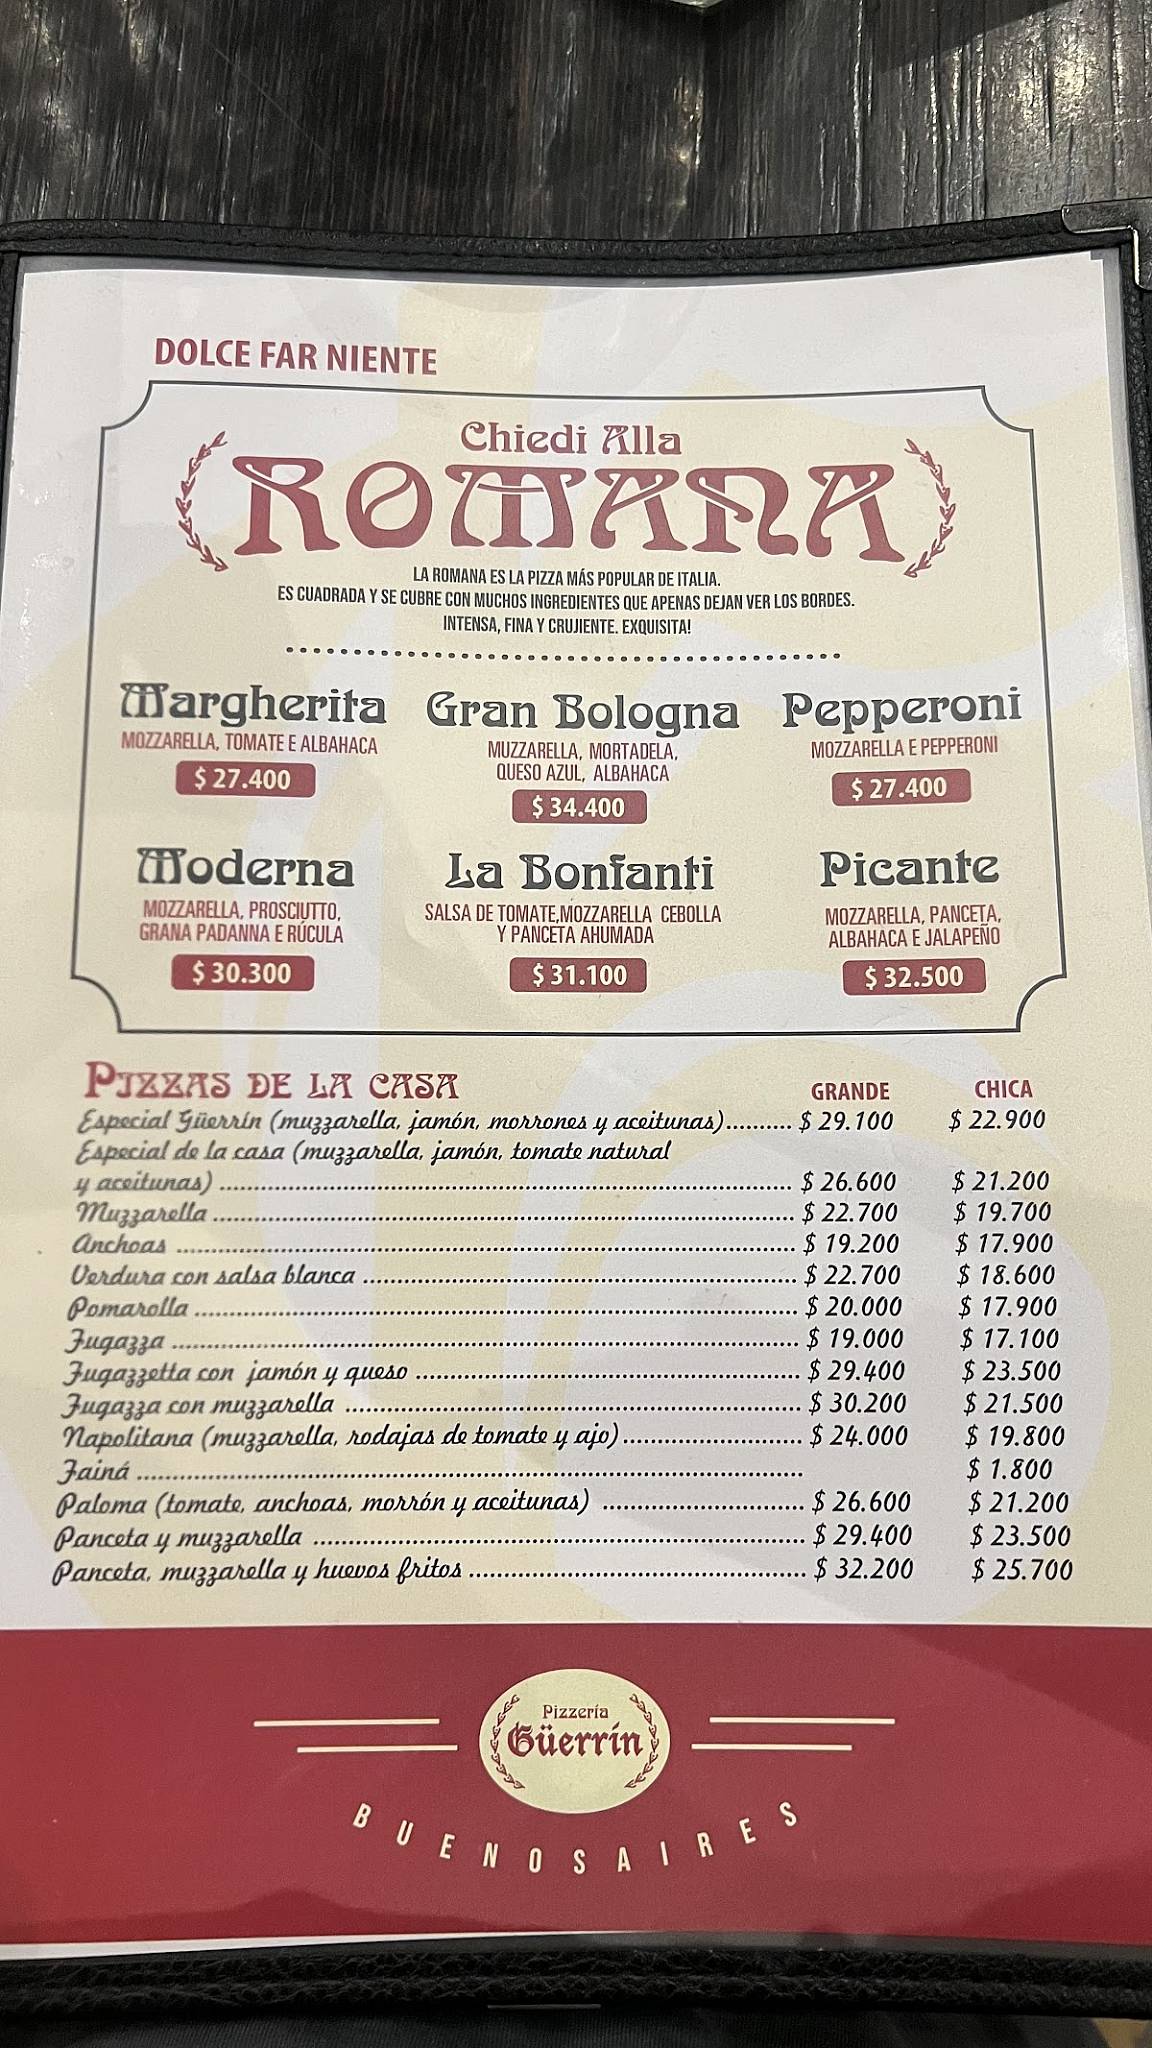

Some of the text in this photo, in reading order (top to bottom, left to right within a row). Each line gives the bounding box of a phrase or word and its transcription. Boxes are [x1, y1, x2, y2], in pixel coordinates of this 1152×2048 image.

[155, 337, 437, 375] DOLCE FAR NIENTE
[460, 421, 682, 455] Chiedi Alla
[232, 456, 905, 562] ROMANA
[413, 566, 721, 587] LA ROMANA ES LA PIZZA MÁS POPULAR DE ITALIA.
[278, 585, 855, 611] ES CUADRADA SE CUBRE CON MUCHOS INGREDIENTES QUE APENAS DEJAN VER LOS BORDES.
[443, 615, 691, 635] INTENSA, FINA CRUJIENTE. EXQUISITA!
[120, 682, 387, 728] Margherita
[426, 690, 740, 738] Gran Bologna
[782, 686, 1022, 735] Pepperoni
[121, 731, 378, 754] MOZZARELLA, TOMATE ALBAHACA
[488, 741, 678, 762] MUZZARELLA, MORTADELA,
[811, 735, 998, 759] MOZZARELLA PEPPERONI
[213, 768, 291, 790] 27.400
[496, 764, 669, 783] QUESO AZUL, ALBAHACA
[869, 776, 947, 800] 27.400
[550, 797, 625, 818] 34.400
[137, 847, 355, 888] Moderna
[445, 852, 715, 891] La Bonfanti
[820, 849, 999, 888] Picante
[143, 900, 341, 921] MOZZARELLA, PROSCIUTTO,
[425, 903, 472, 922] SALSA
[476, 905, 494, 922] DE
[661, 905, 722, 923] CEBOLLA
[825, 904, 1001, 926] MOZZARELLA, PANCETA,
[140, 921, 343, 944] GRANA PADANNA RÚCULA
[511, 925, 654, 944] PANCETA AHUMADA
[828, 923, 1000, 949] ALBAHACA JALAPEÑO
[211, 962, 292, 984] 30.300
[550, 964, 628, 986] 31.100
[884, 965, 964, 988] 32.500
[811, 1082, 890, 1101] GRANDE
[974, 1079, 1033, 1099] CHICA
[76, 1108, 172, 1135] Especial
[178, 1108, 262, 1135] Güerrín
[270, 1109, 401, 1135] (muzzarella,
[408, 1109, 480, 1136] jamón,
[487, 1113, 587, 1130] morrones
[817, 1110, 894, 1132] 29.100
[968, 1109, 1046, 1130] 22.900
[75, 1139, 673, 1167] Especial casa (muzzarella, jamón, tomate natural
[96, 1170, 1050, 1195] aceitunas) 26.600 21.200
[76, 1201, 1052, 1228] Muzzarella 22.700 19.700
[71, 1232, 1054, 1255] Anchoas 19.200 17.900
[70, 1263, 1055, 1287] Verdura salsa blanca 22.700 18.600
[66, 1295, 1058, 1322] Pomarolla 20.000 17.900
[64, 1327, 1060, 1355] Fugazza 19.000 17.100
[62, 1360, 1062, 1388] Fugazzetta jamón queso 29.400 23.500
[60, 1391, 1064, 1420] Fugazza muzzarella 30.200 21.500
[63, 1425, 194, 1454] Napolitana
[201, 1425, 338, 1452] (muzzarella,
[346, 1423, 435, 1452] rodajas
[441, 1423, 467, 1445] de
[472, 1425, 548, 1444] tomate
[830, 1424, 909, 1447] 24.000
[989, 1425, 1065, 1447] 19.800
[56, 1458, 1053, 1485] Fainá 1.800
[55, 1487, 1069, 1519] Paloma (tomate, anchoas, morrón aceitunas) 26.600 21.200
[53, 1524, 1071, 1553] Panceta muzzarella 29.400 23.500
[51, 1555, 1074, 1587] Panceta, muzzarella huevos fritos 32.200 25.700
[542, 1704, 609, 1719] Pizzería
[507, 1720, 644, 1758] Güerrín
